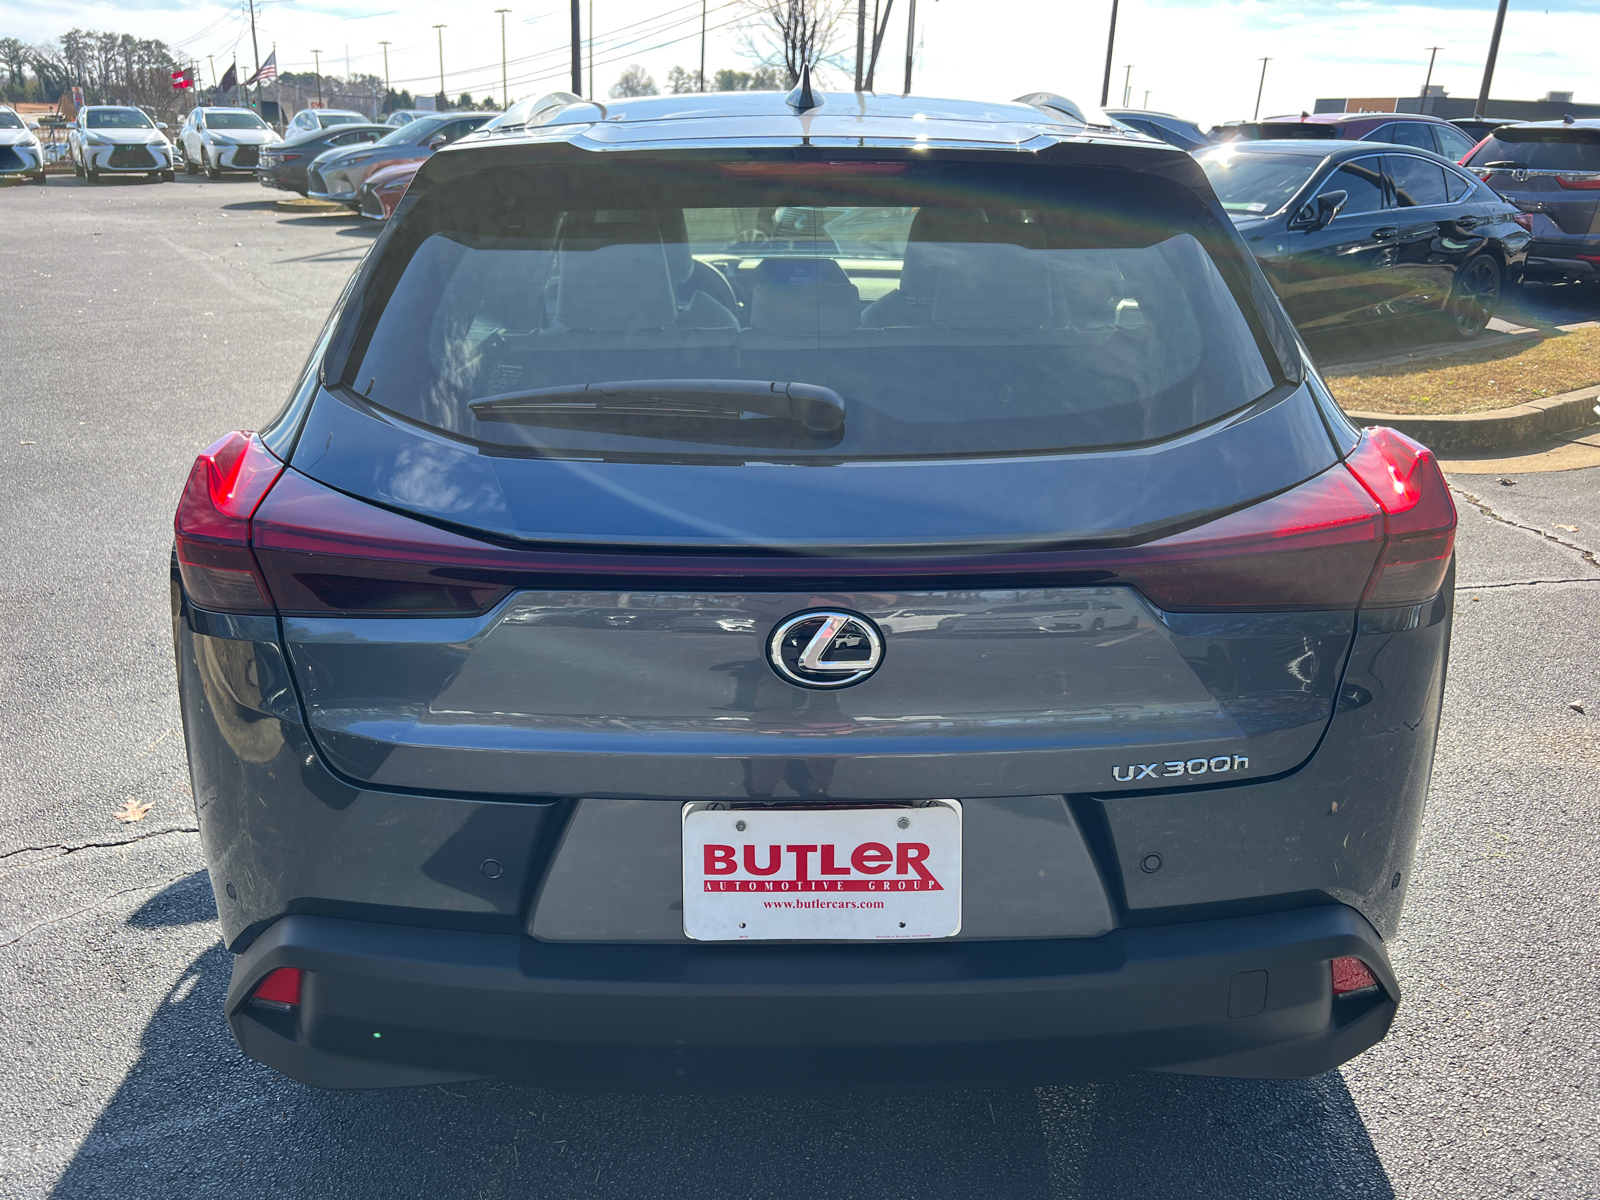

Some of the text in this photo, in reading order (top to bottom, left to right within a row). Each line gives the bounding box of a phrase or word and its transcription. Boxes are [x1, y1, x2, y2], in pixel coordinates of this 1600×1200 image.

[1112, 754, 1249, 782] UX 300h
[705, 880, 937, 892] AUTOMOTIVE GROUP
[763, 899, 885, 910] www.butlercars.com
